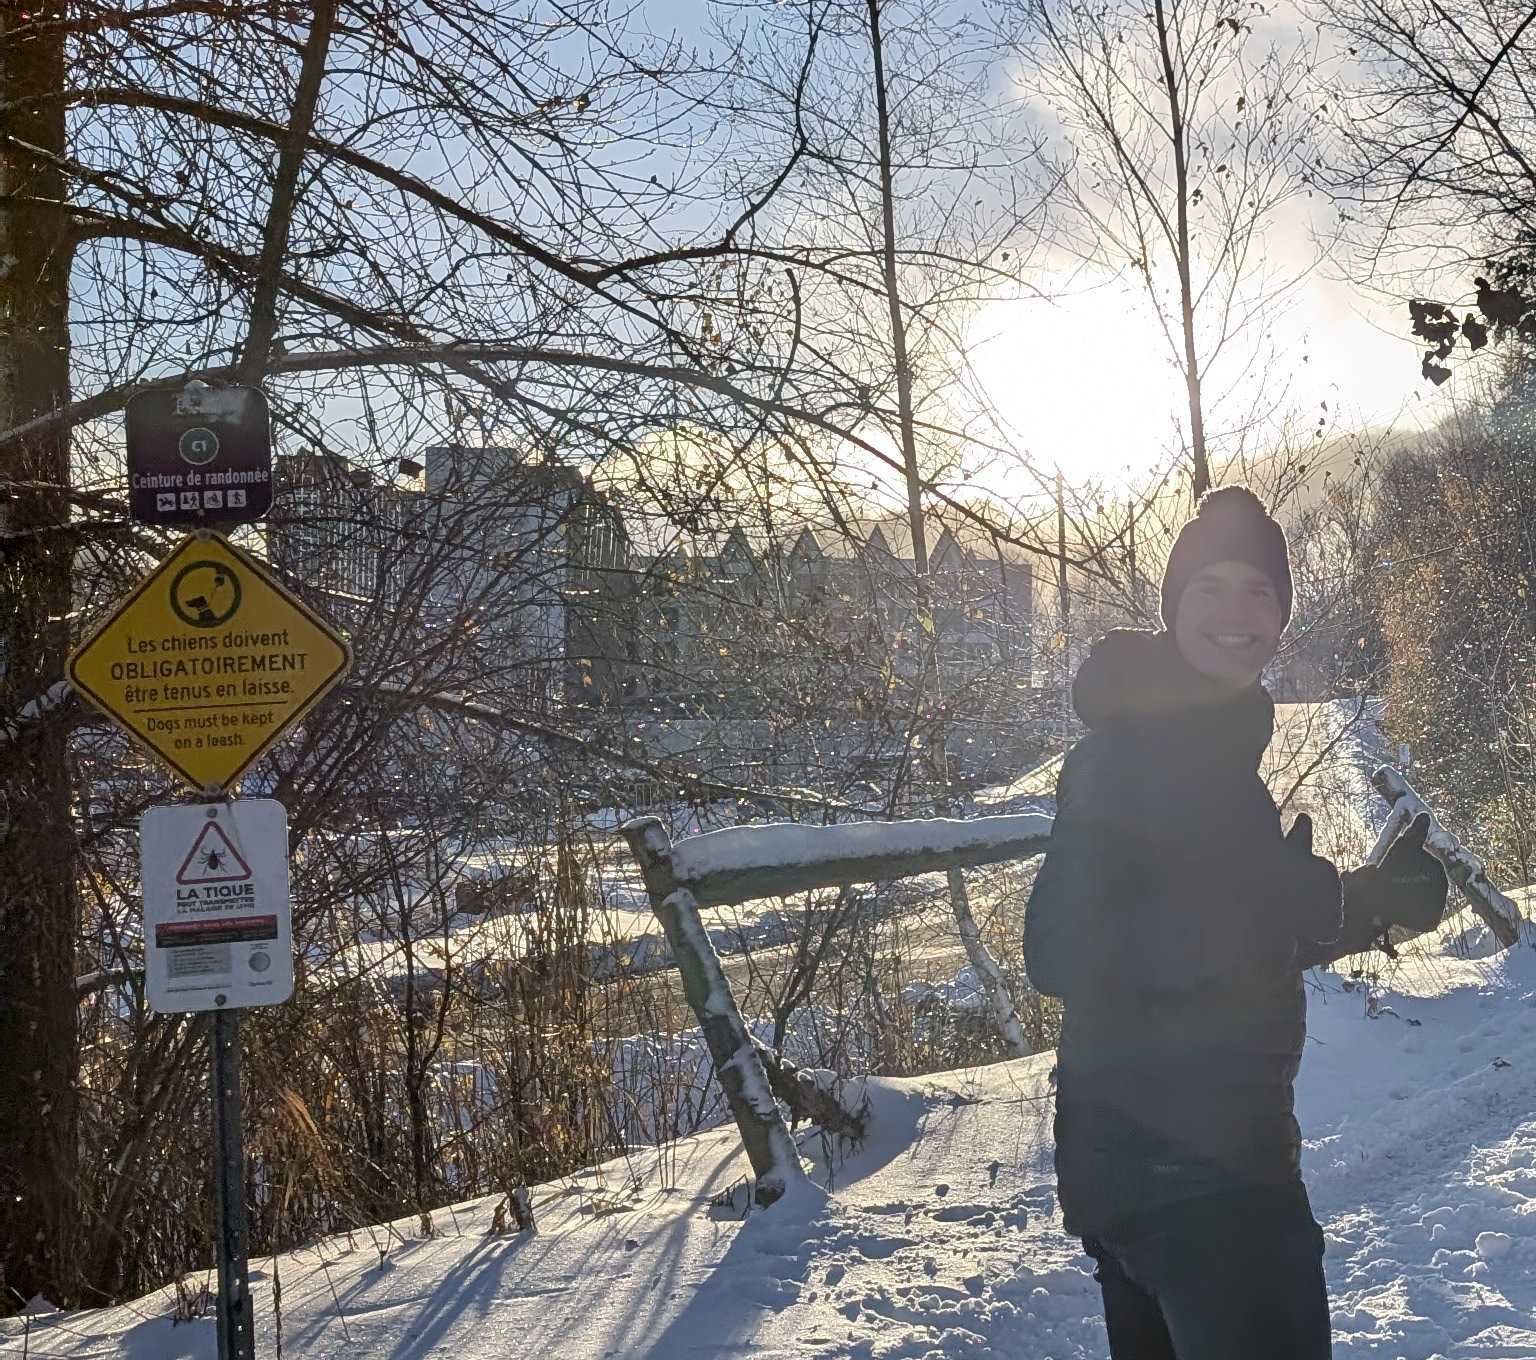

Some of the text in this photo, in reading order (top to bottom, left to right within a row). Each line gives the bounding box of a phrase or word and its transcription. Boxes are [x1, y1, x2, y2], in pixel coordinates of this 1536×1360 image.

[132, 467, 269, 489] Ceinture de randonnée
[128, 629, 289, 653] Les chiens doivent
[111, 653, 308, 680] OBLIGATOIREMENT
[125, 679, 294, 703] être tenus en laisse.
[147, 710, 274, 734] Dogs must be kept
[175, 737, 192, 750] on
[196, 736, 203, 748] a
[177, 883, 255, 900] LA TIQUE
